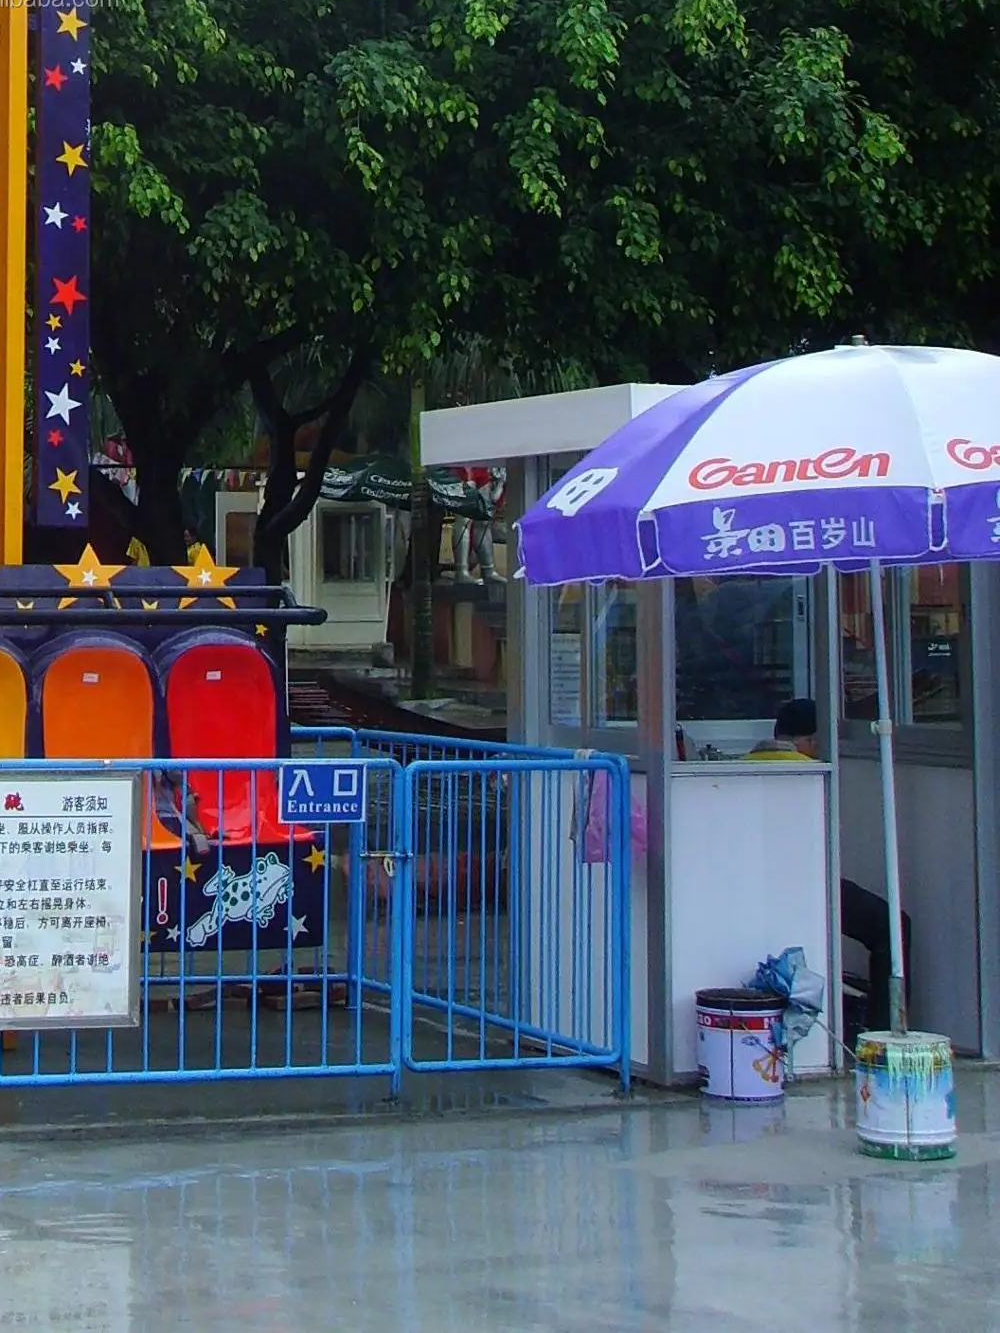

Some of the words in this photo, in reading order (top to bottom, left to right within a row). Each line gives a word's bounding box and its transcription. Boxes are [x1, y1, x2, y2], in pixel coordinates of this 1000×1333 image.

[700, 507, 877, 560] 景田百岁山
[288, 769, 358, 797] 入口
[62, 795, 109, 812] 游客须知
[287, 799, 359, 813] Entrance
